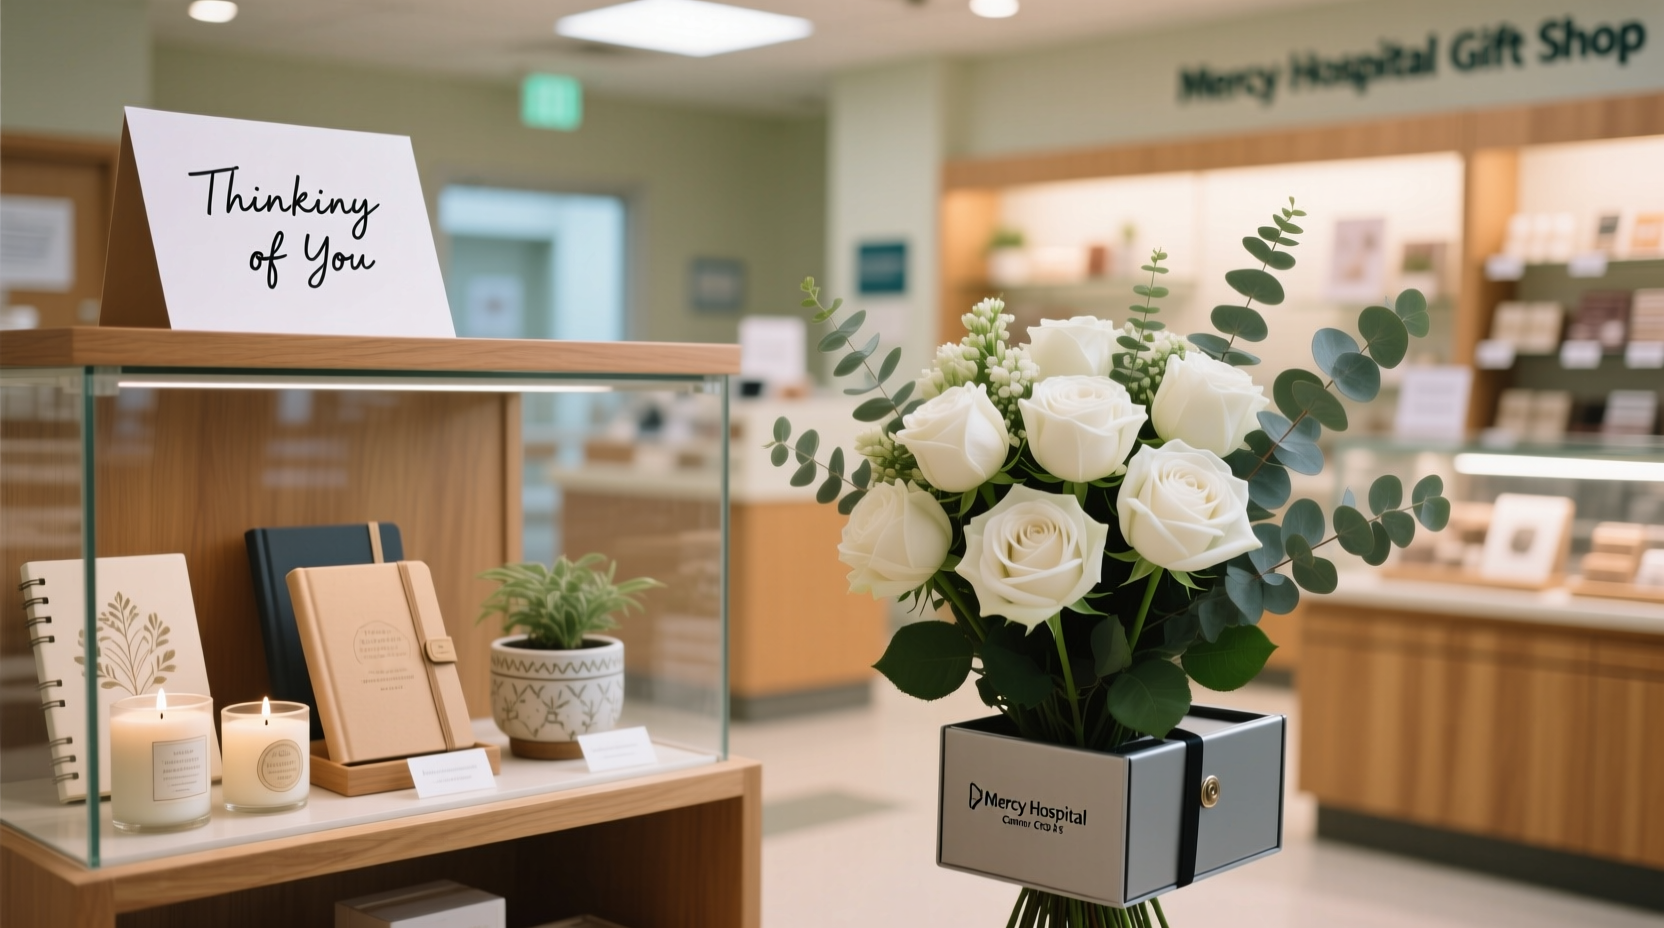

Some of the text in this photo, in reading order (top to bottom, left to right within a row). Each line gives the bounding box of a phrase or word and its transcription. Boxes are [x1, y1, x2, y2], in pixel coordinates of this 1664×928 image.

[1179, 17, 1646, 105] Mercy Hospital Gift Shop
[249, 230, 376, 289] of You
[985, 790, 1086, 825] Mercy Hospital
